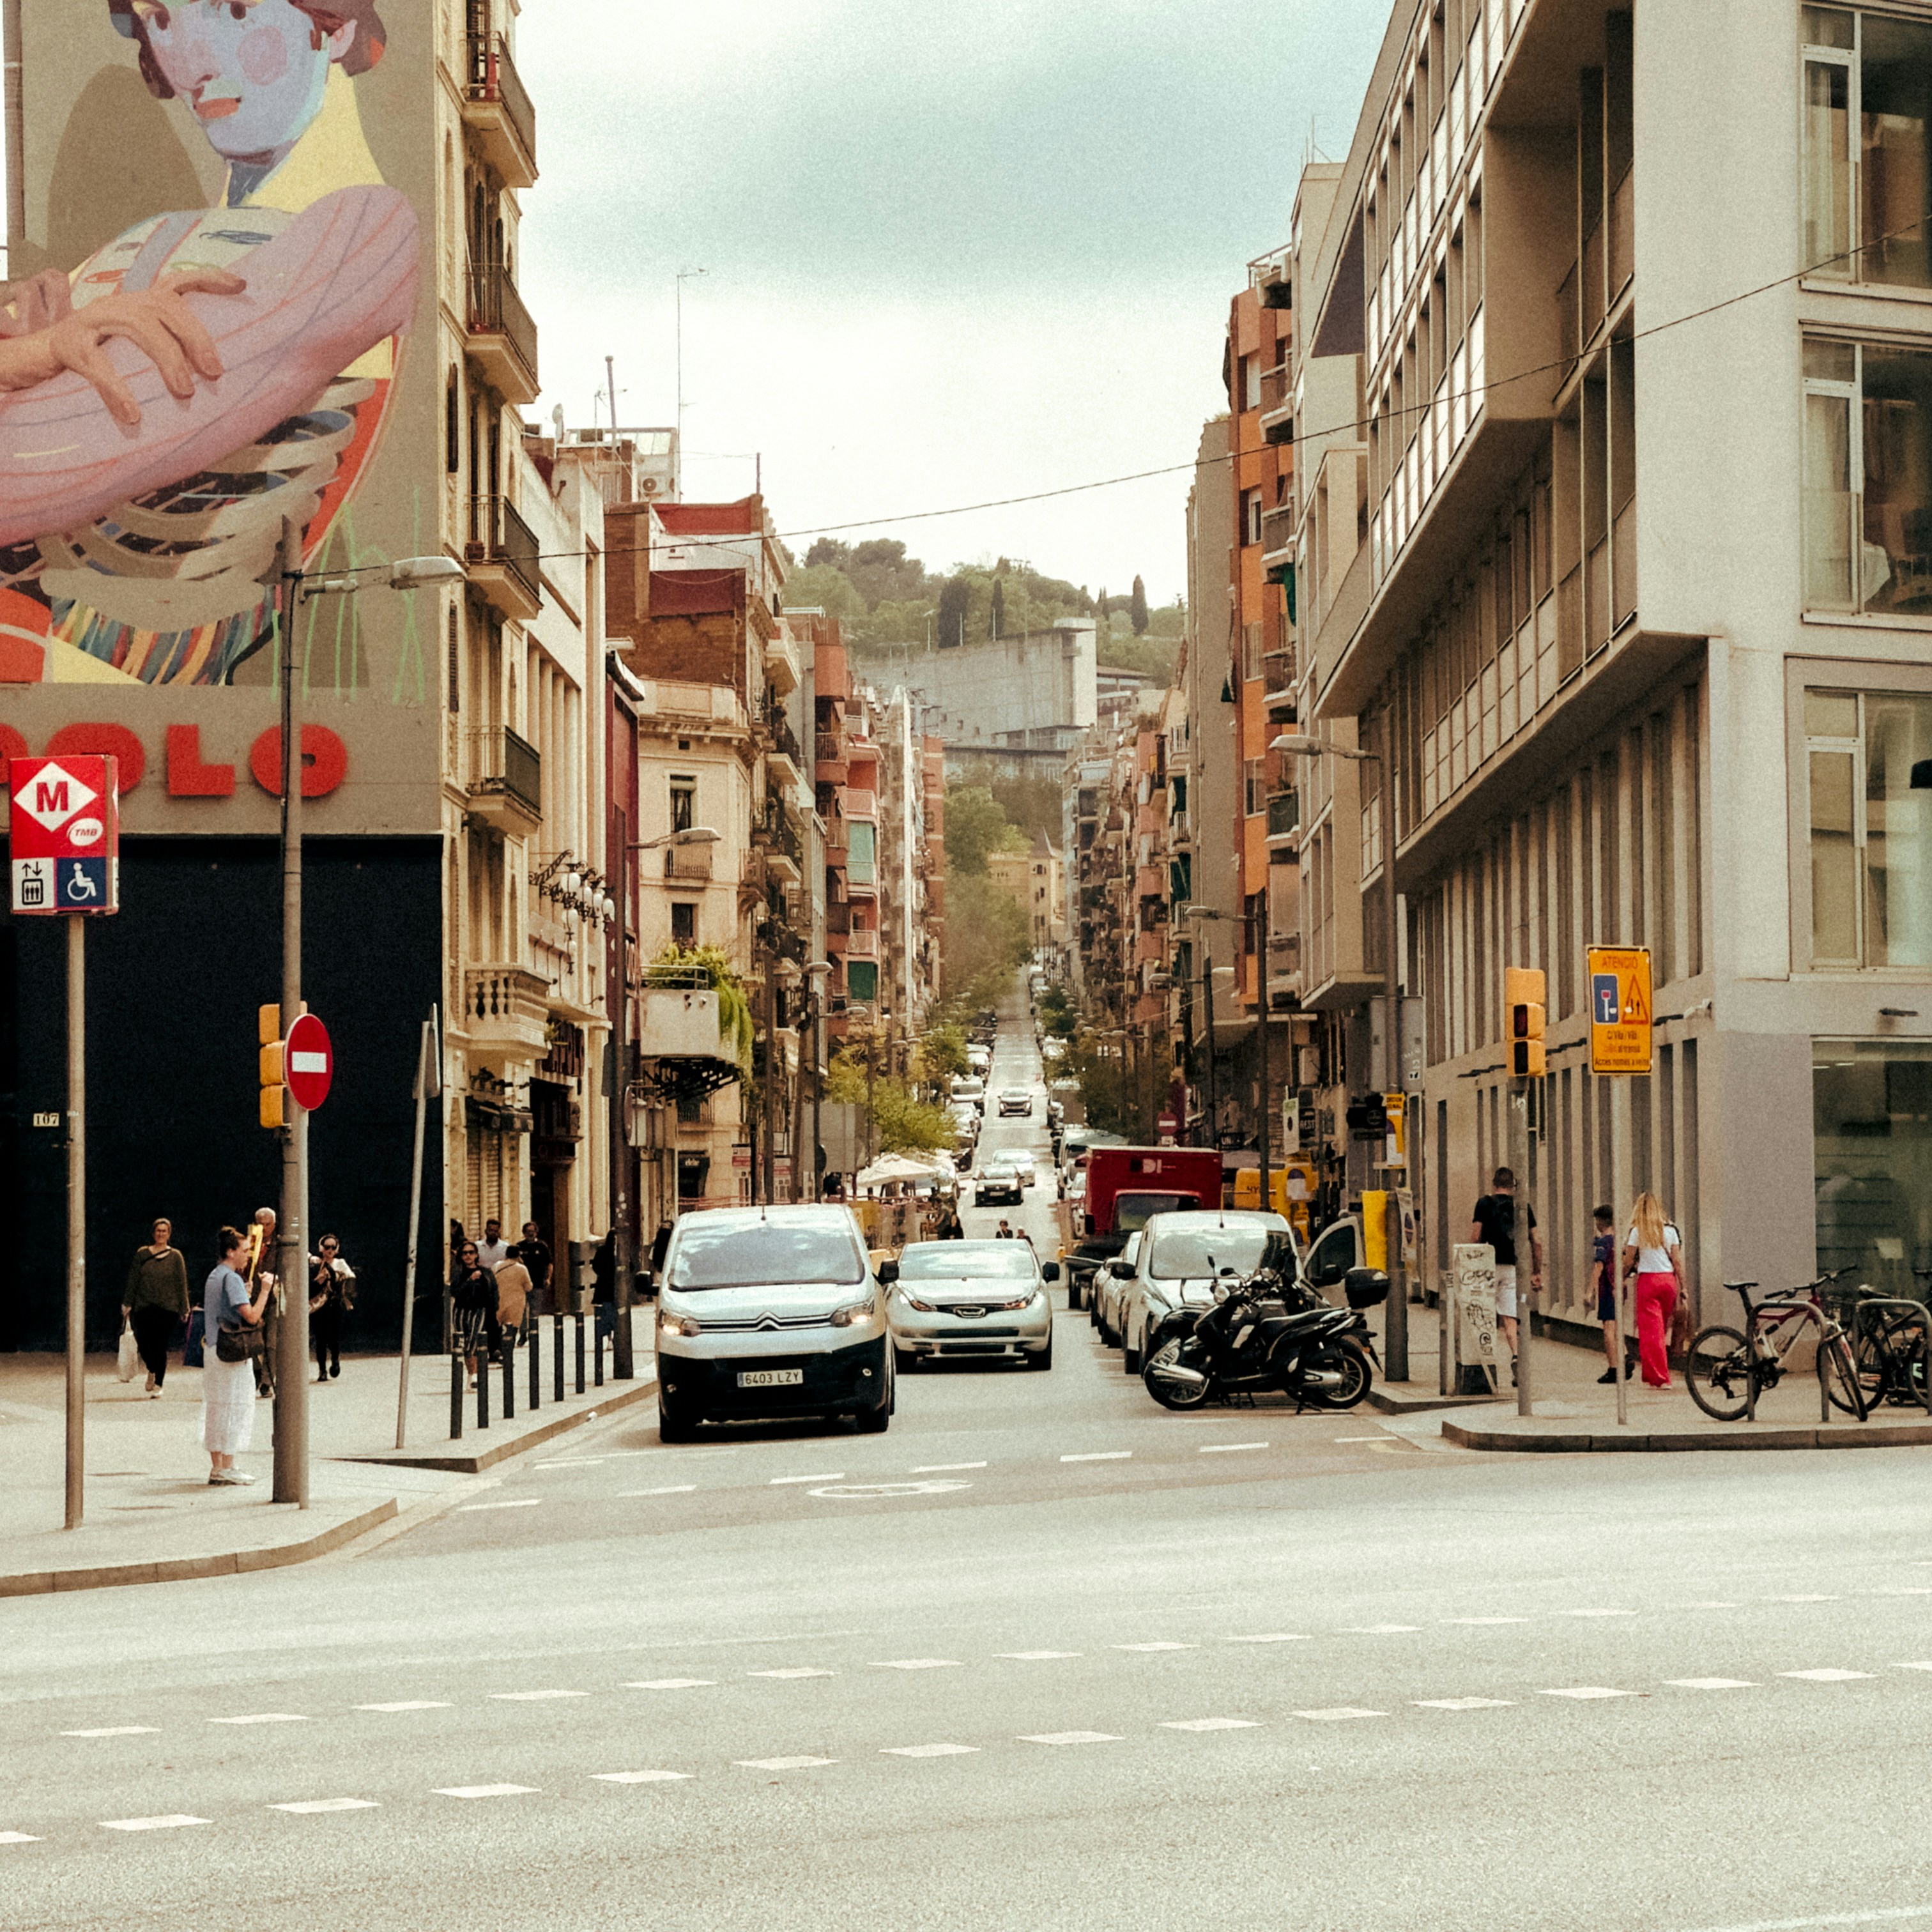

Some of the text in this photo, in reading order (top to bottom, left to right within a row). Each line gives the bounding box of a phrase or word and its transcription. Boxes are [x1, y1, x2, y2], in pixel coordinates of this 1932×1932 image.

[36, 781, 69, 813] M
[75, 828, 98, 837] TMB
[36, 1114, 58, 1124] 107
[745, 1372, 799, 1384] 6403 LZY
